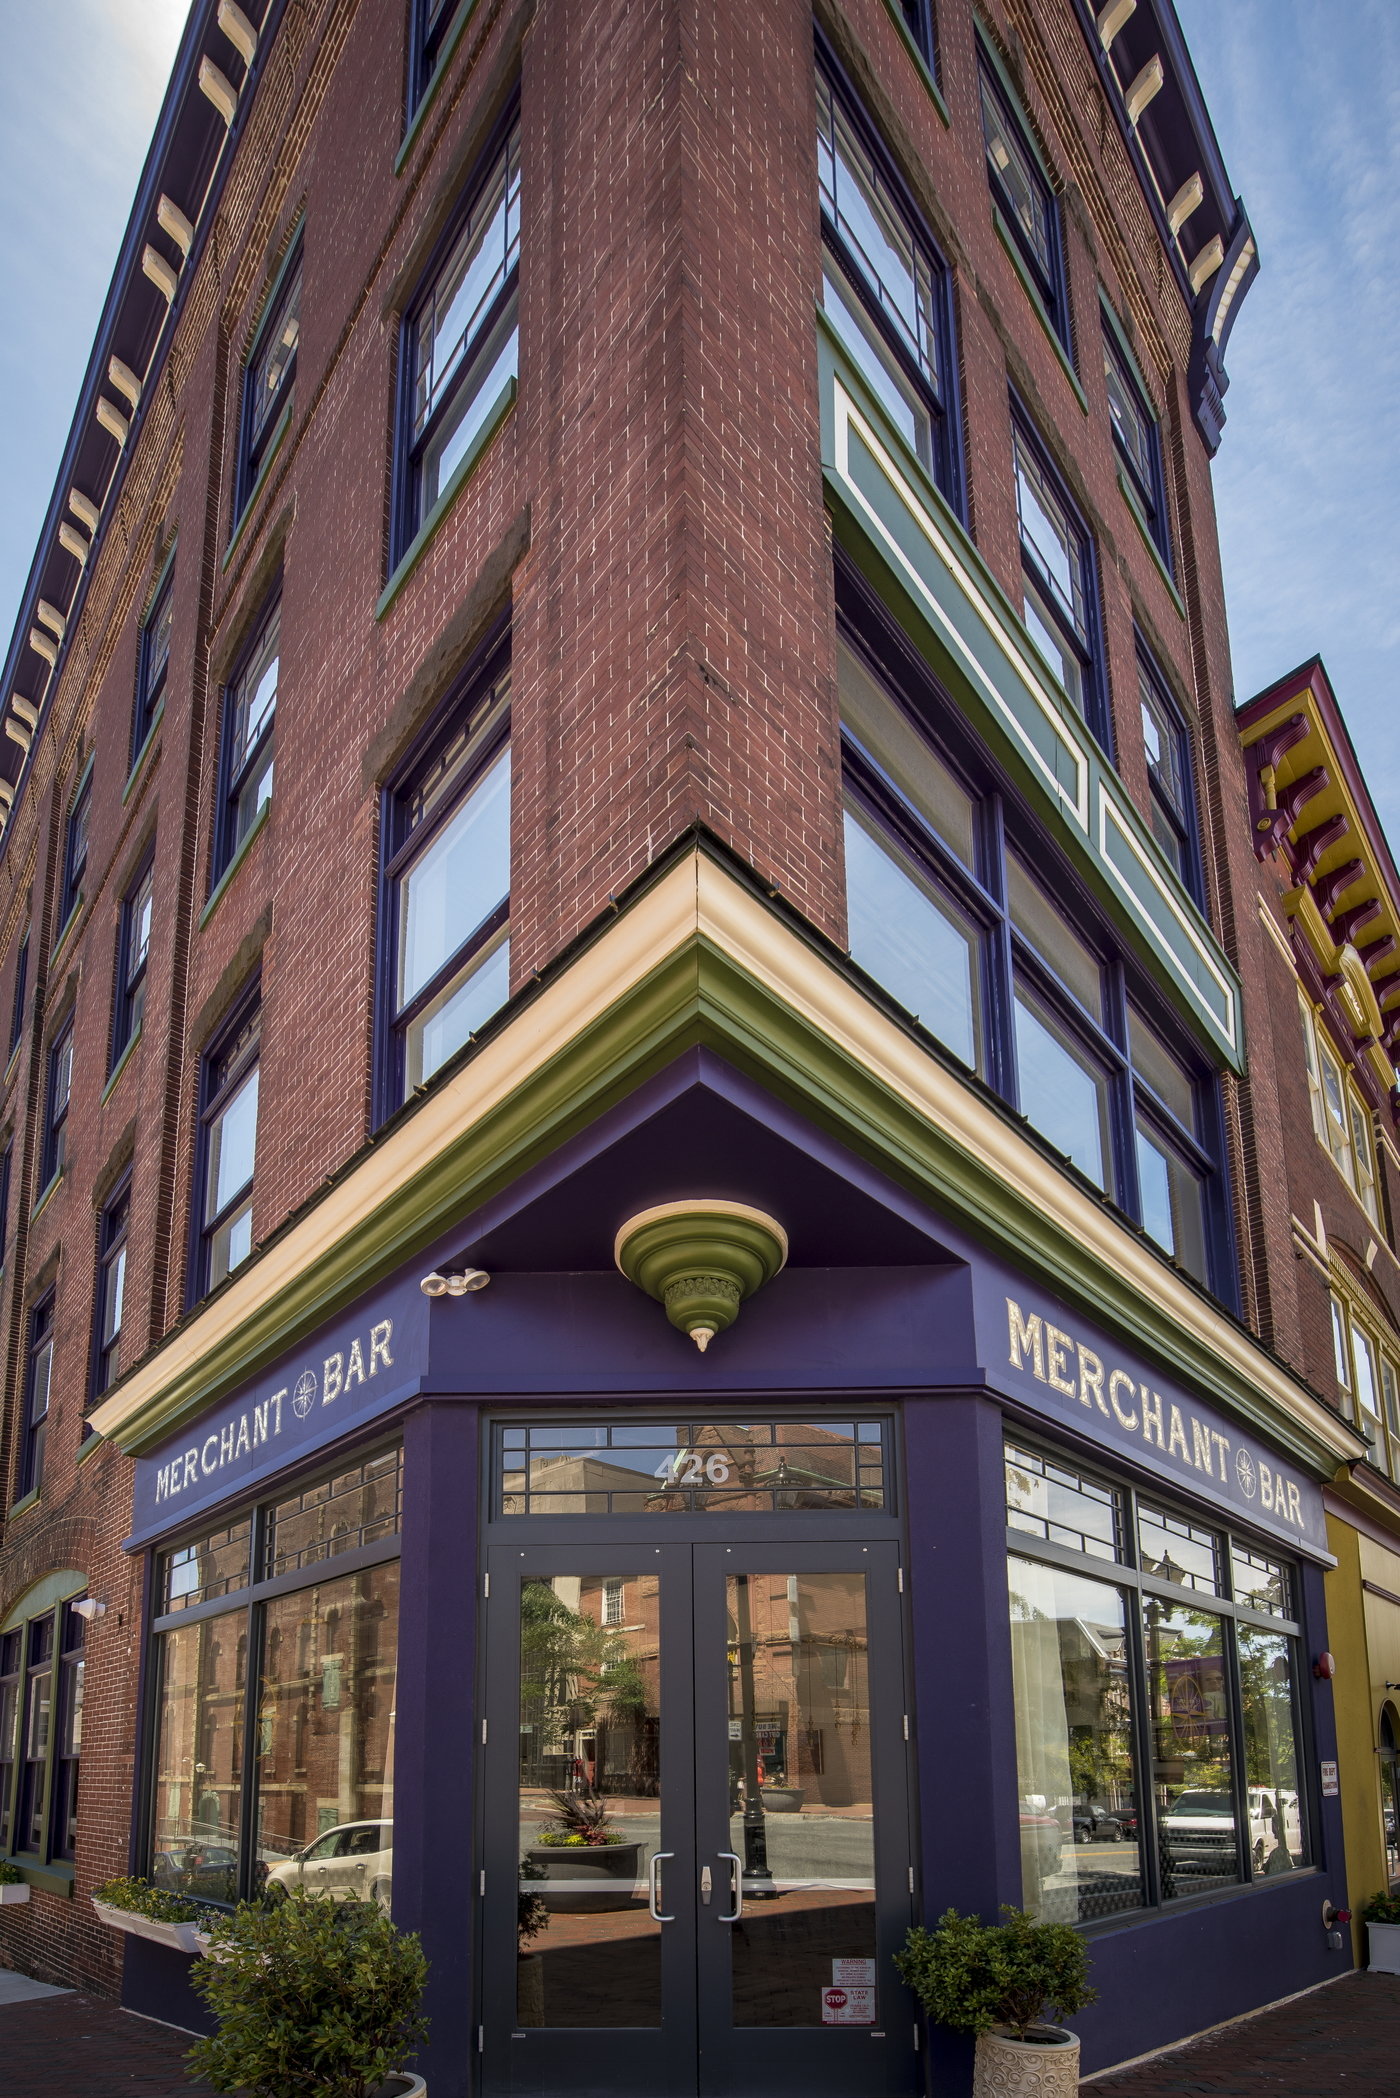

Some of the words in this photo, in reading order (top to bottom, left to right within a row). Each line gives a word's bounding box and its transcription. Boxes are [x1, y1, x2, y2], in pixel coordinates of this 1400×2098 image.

[155, 1387, 288, 1505] MERCHANT
[321, 1318, 394, 1407] BAR
[1005, 1297, 1230, 1483] MERCHANT
[1257, 1461, 1305, 1530] BAR
[654, 1453, 729, 1483] 426
[826, 1995, 846, 2003] STOP
